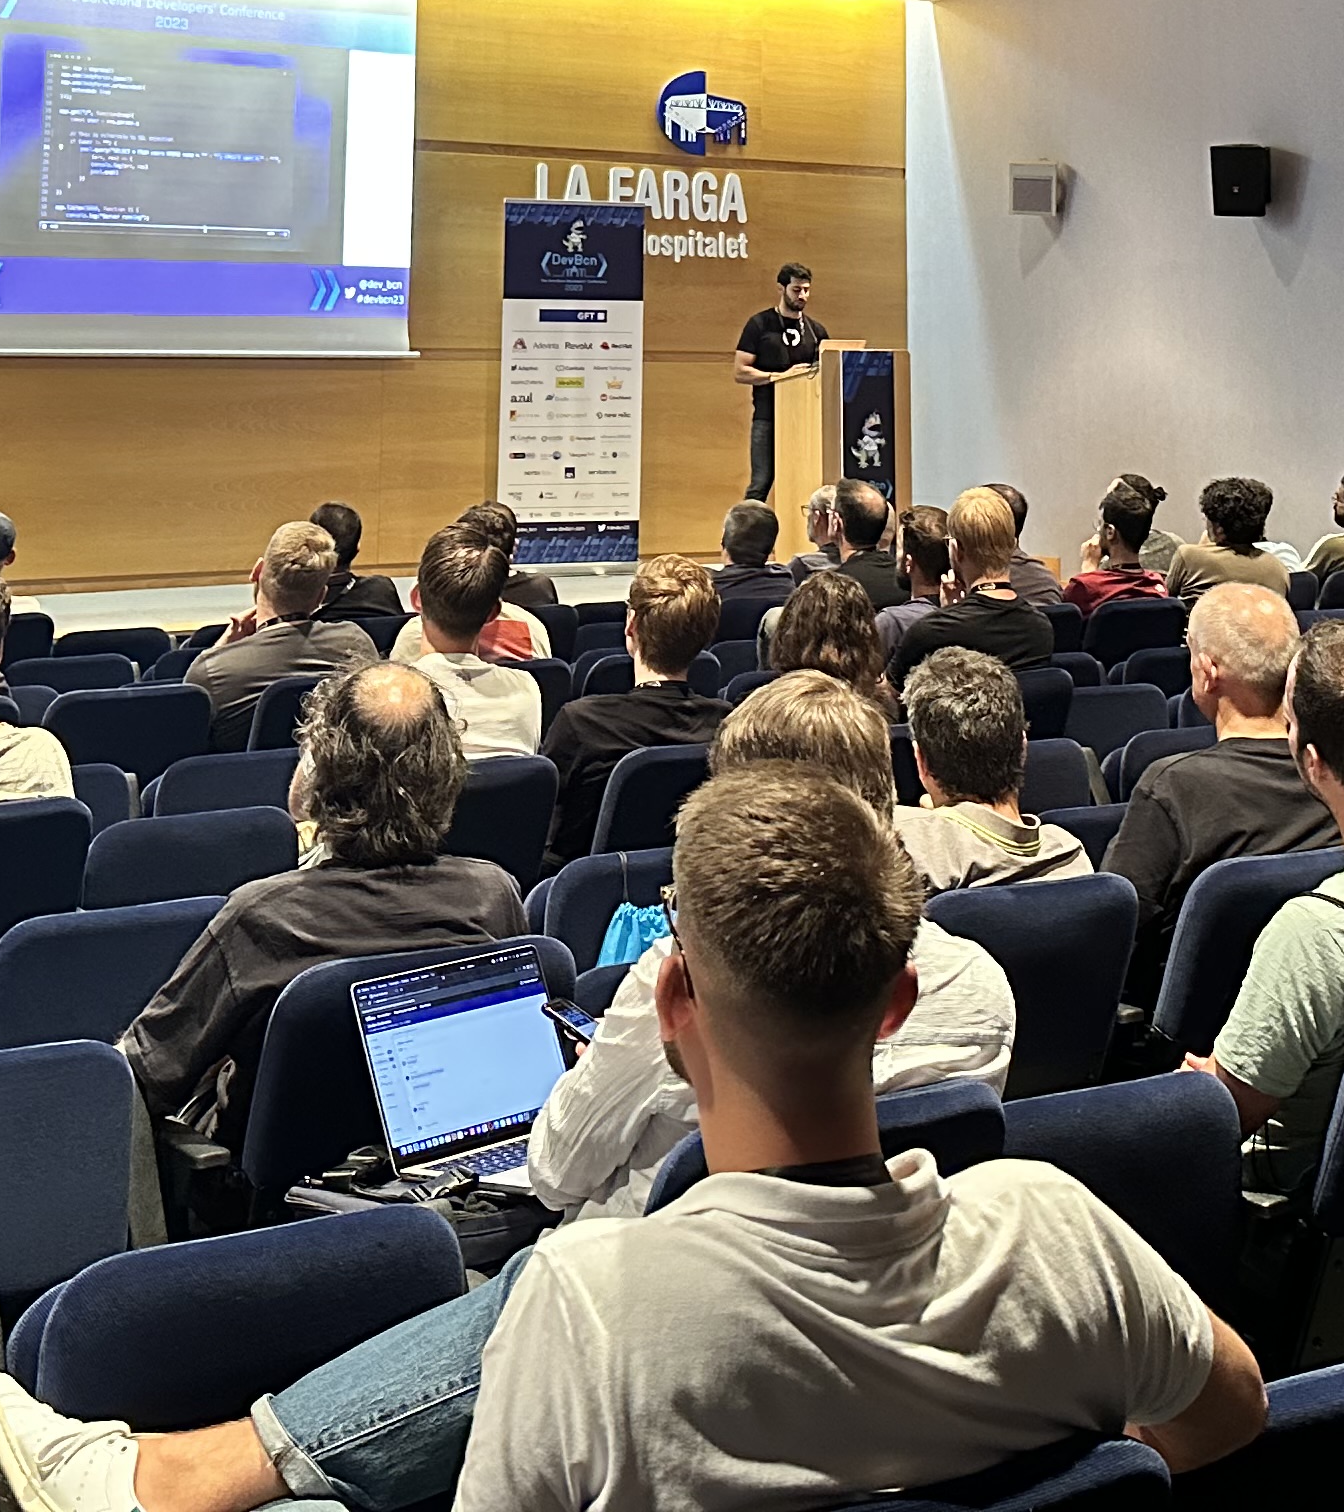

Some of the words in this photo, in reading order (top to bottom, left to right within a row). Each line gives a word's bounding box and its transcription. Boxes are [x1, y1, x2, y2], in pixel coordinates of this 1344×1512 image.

[220, 3, 286, 21] Conference
[155, 15, 189, 31] 2023
[536, 162, 592, 201] LA
[609, 167, 748, 224] FARGA
[643, 228, 749, 263] ospitalet
[551, 253, 598, 267] DevBcn
[577, 312, 596, 321] GFT
[564, 341, 594, 350] Revolut
[510, 392, 533, 404] azul
